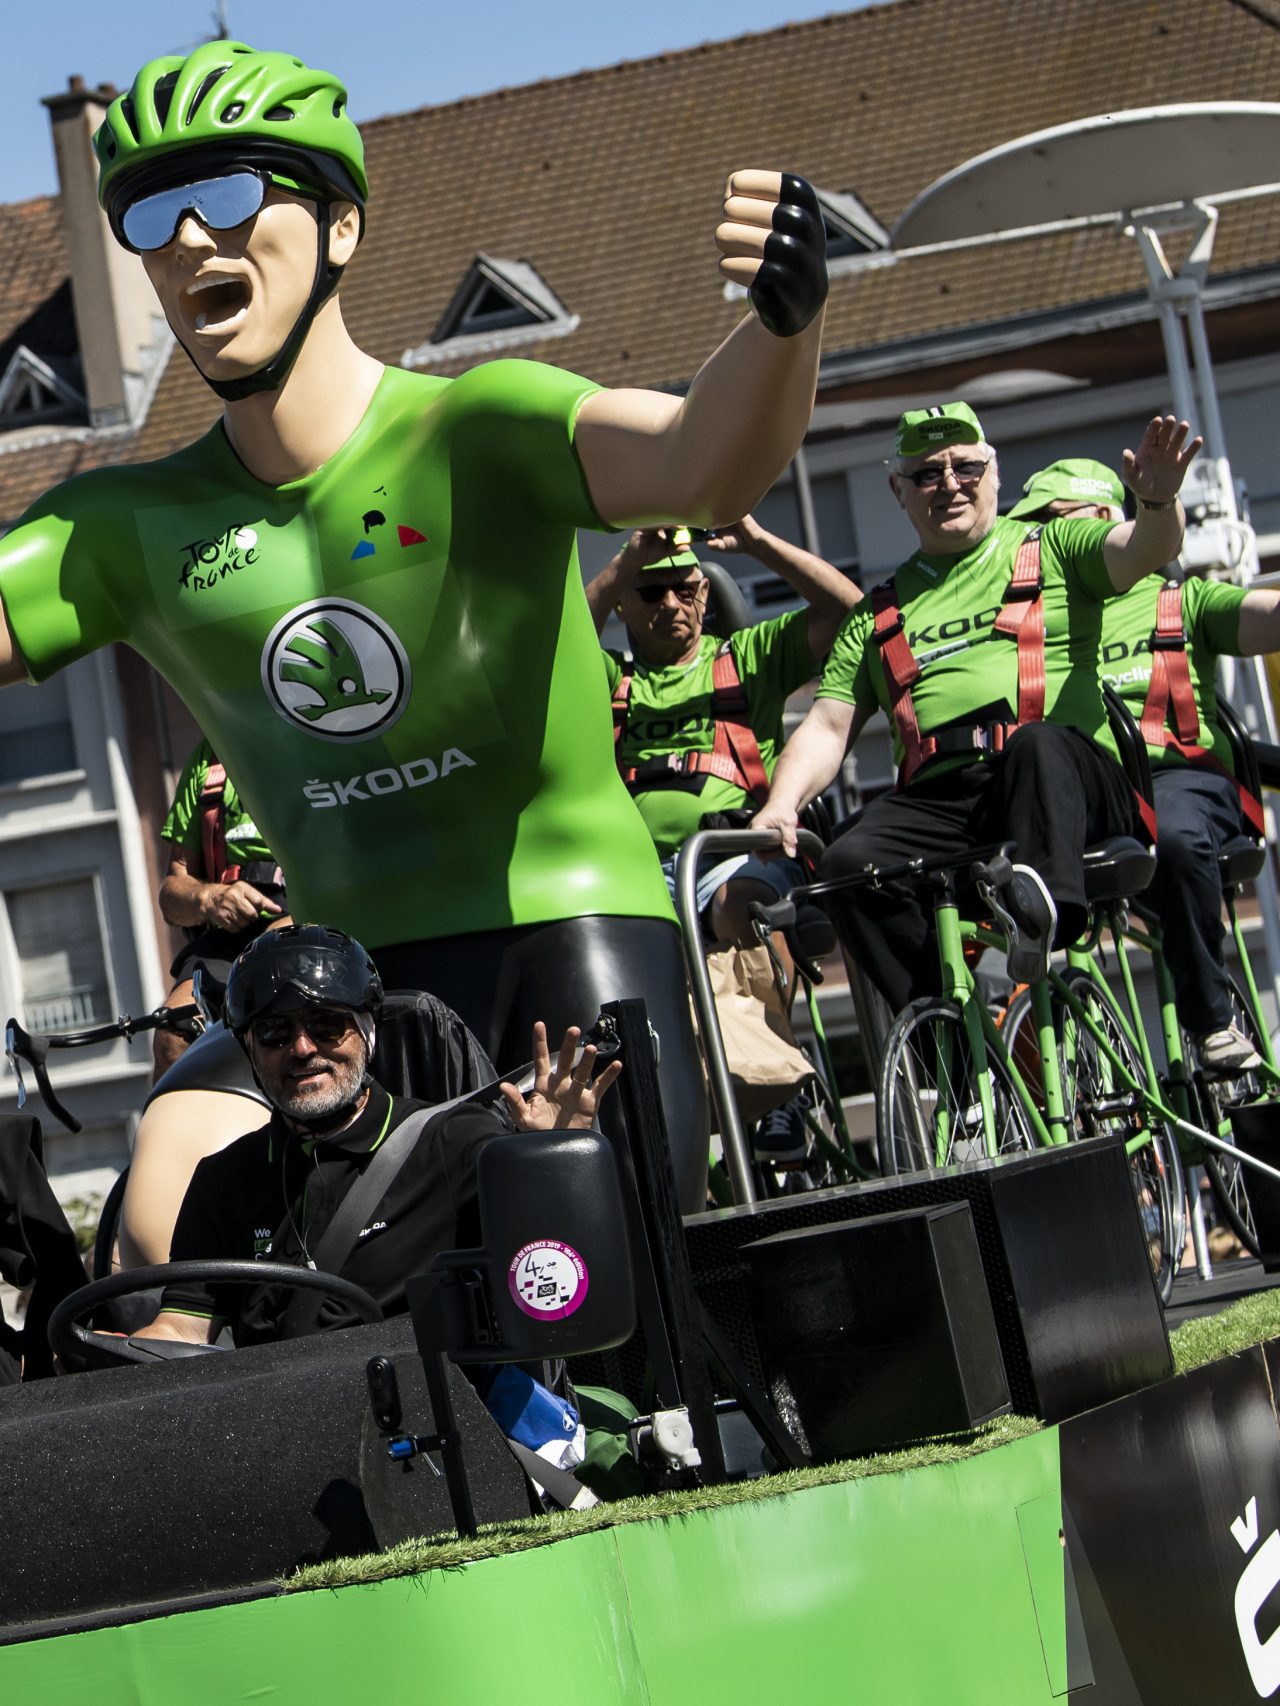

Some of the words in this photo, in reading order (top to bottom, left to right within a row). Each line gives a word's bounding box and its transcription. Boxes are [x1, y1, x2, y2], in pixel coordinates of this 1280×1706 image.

[909, 606, 1003, 649] KOD
[303, 747, 477, 808] ŠKODA
[254, 1228, 271, 1239] We
[510, 1256, 520, 1272] TOUR
[517, 1251, 526, 1260] DE
[524, 1241, 546, 1253] FRANCE
[546, 1241, 561, 1249] 2019
